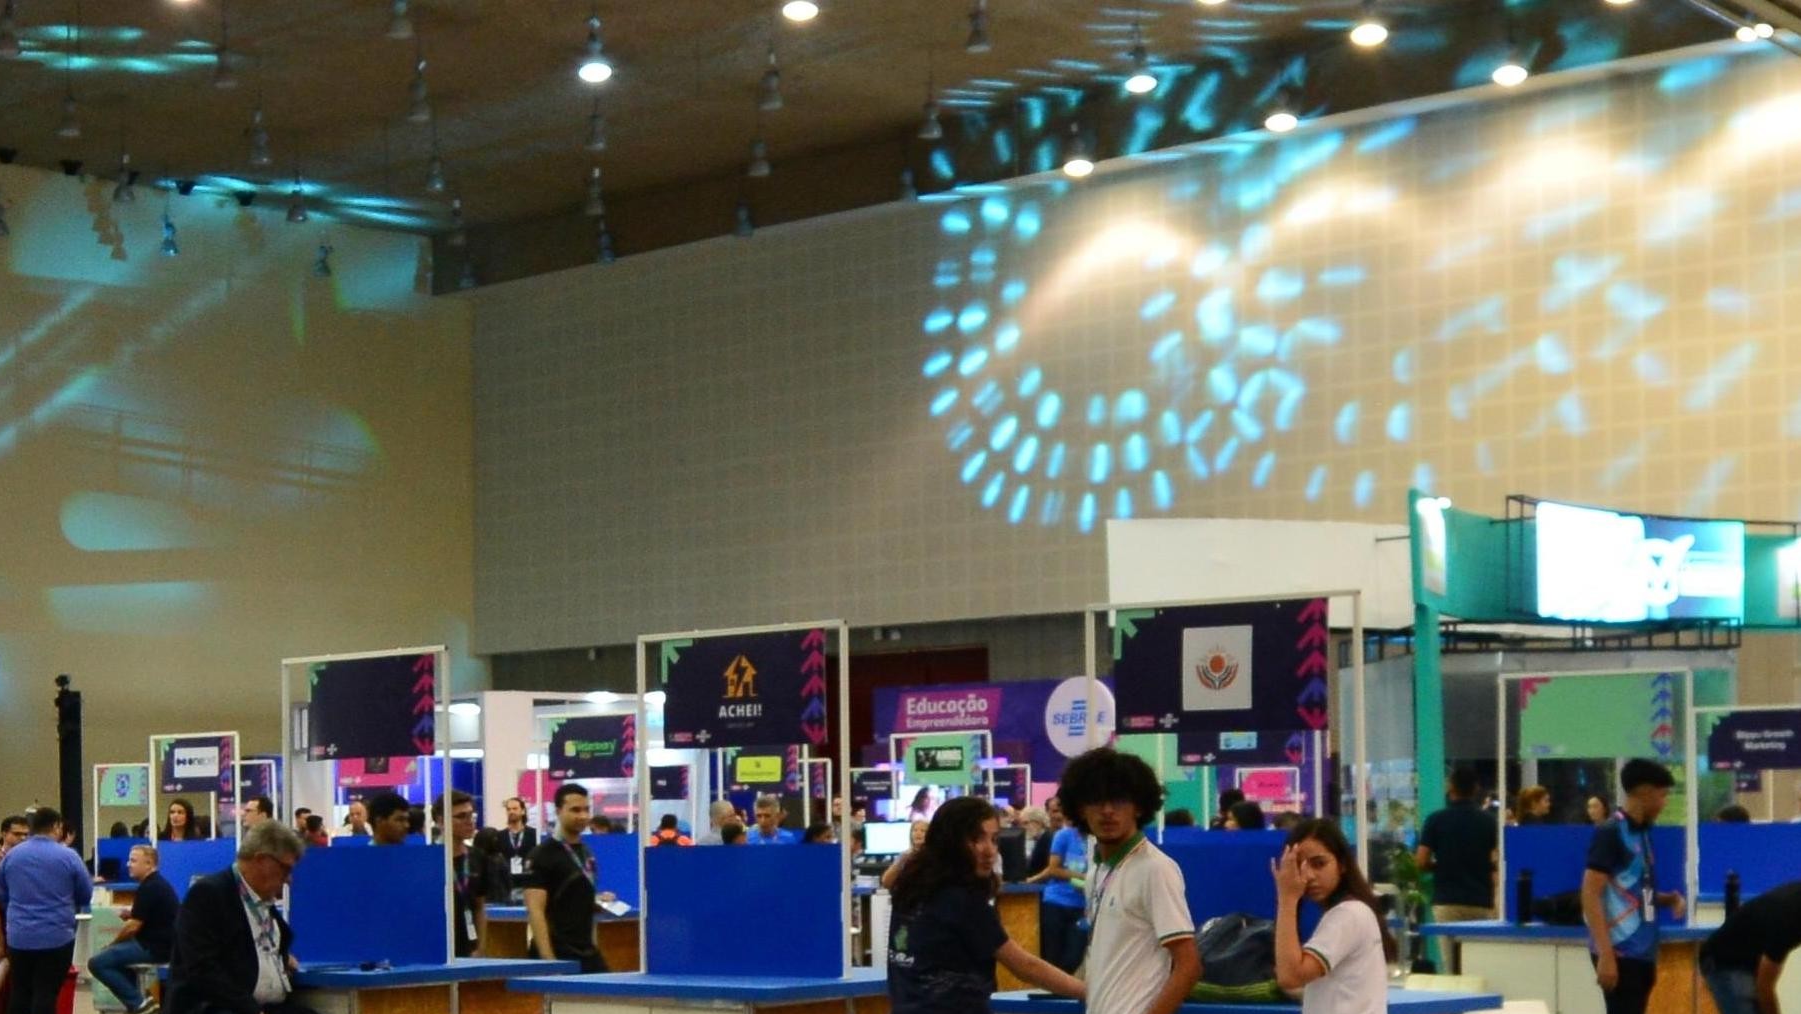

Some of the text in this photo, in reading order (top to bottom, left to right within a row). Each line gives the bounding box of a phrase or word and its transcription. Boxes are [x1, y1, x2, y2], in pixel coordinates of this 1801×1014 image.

[718, 704, 762, 718] ACHEI!
[906, 694, 988, 717] Educação
[906, 714, 989, 730] Empreendedora
[1053, 710, 1105, 724] SEBRE
